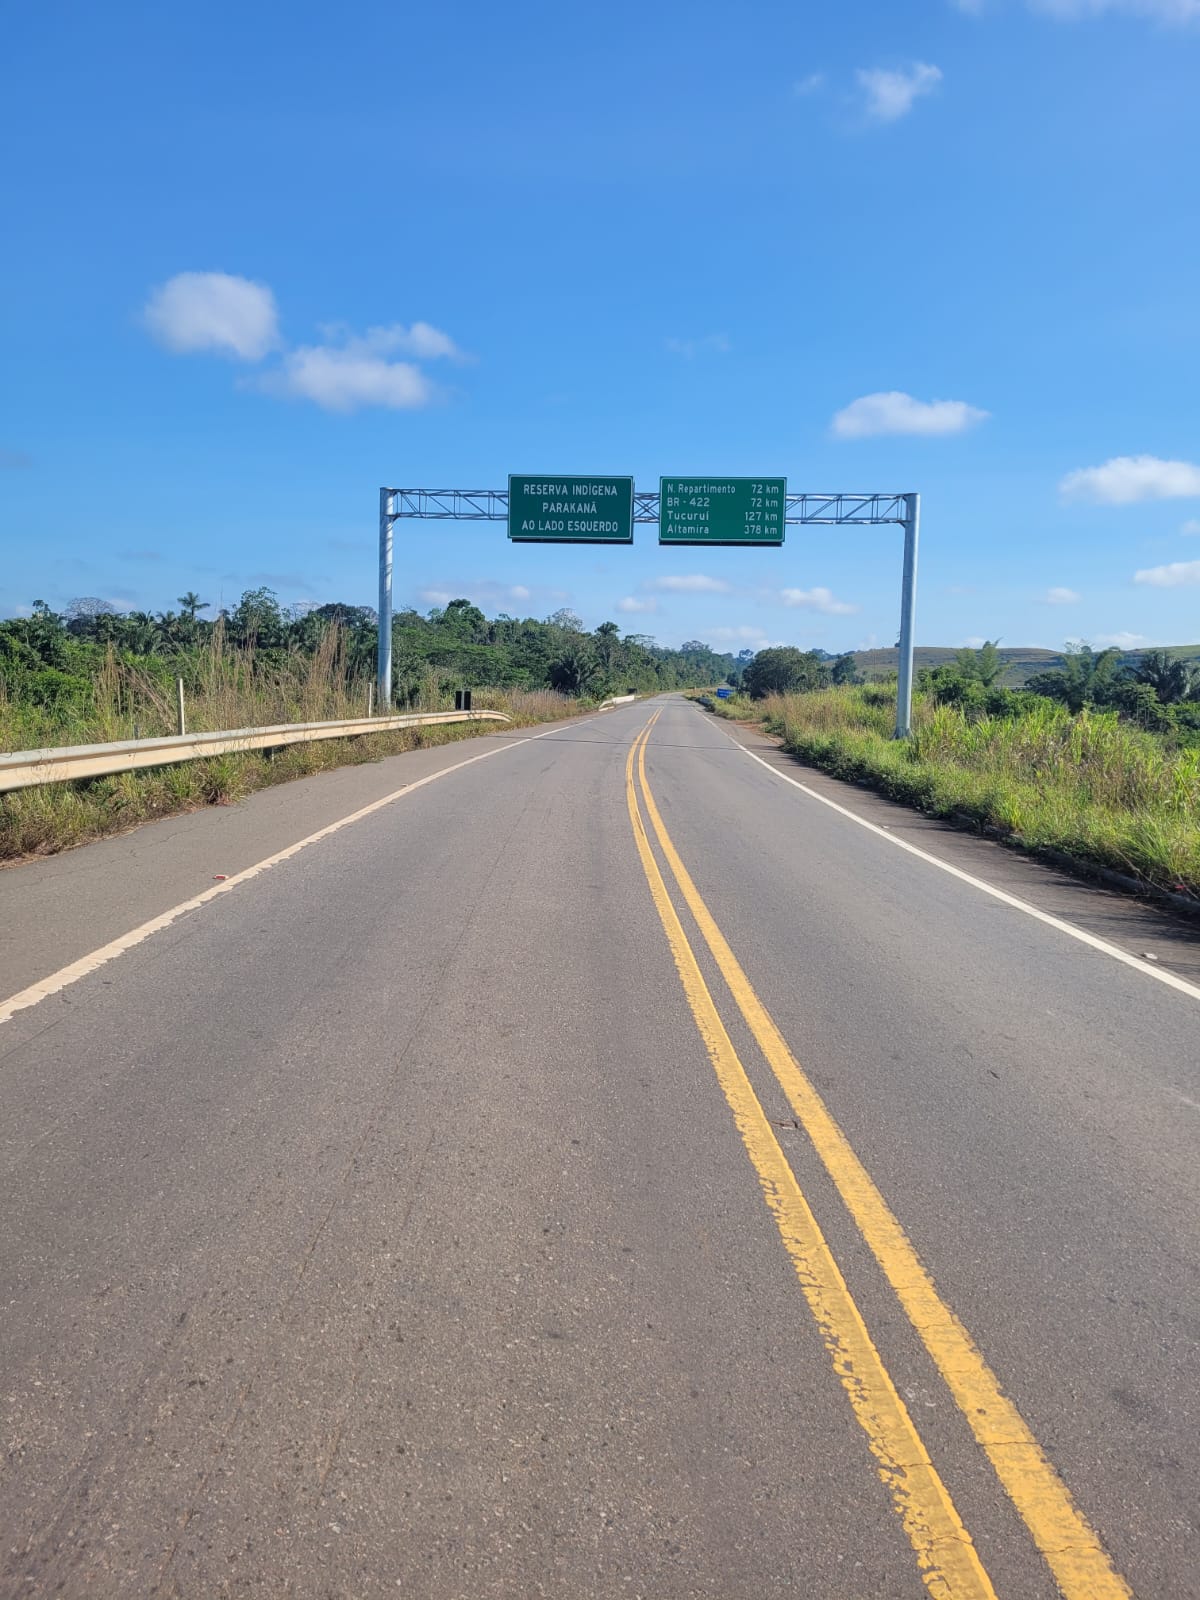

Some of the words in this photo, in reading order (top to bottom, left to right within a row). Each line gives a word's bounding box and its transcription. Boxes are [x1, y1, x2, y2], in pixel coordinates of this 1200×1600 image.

[524, 484, 568, 495] RESERVA
[572, 482, 618, 496] INDÍGENA
[667, 484, 675, 494] N.
[678, 484, 736, 495] Repartimento
[752, 484, 762, 494] 72
[766, 484, 779, 494] km
[543, 502, 597, 513] PARAKANÃ
[667, 498, 679, 506] BR
[689, 498, 710, 506] 422
[751, 498, 762, 507] 72
[765, 498, 778, 507] km
[745, 512, 761, 520] 127
[765, 512, 778, 521] km
[522, 520, 535, 530] AO
[539, 520, 564, 531] LADO
[568, 521, 618, 532] ESQUERDO
[667, 525, 709, 534] Altamira
[744, 525, 761, 534] 378
[764, 525, 777, 534] km
